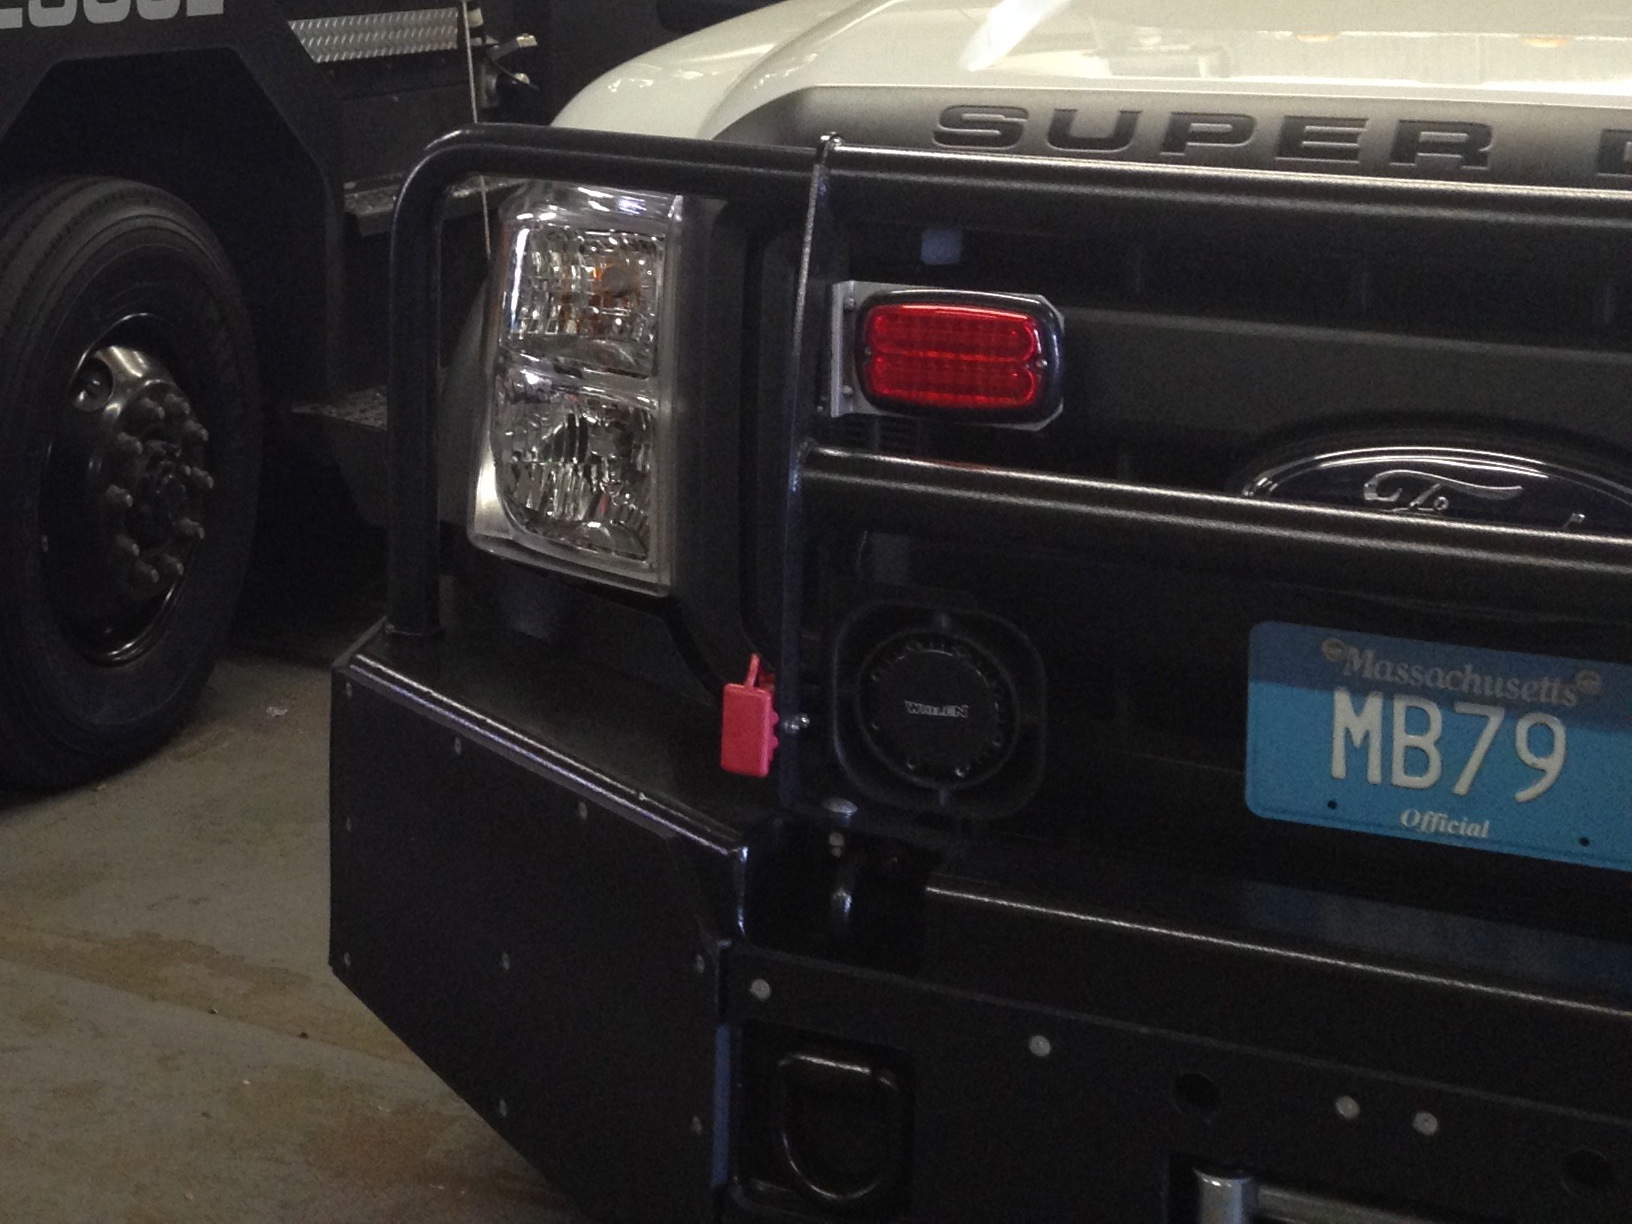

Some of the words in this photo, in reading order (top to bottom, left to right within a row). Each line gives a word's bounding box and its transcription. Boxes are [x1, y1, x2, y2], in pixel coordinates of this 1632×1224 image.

[932, 104, 1494, 172] SUPER
[1342, 646, 1579, 708] Massachusetts
[1330, 686, 1567, 803] MB79
[1399, 808, 1491, 839] Official
